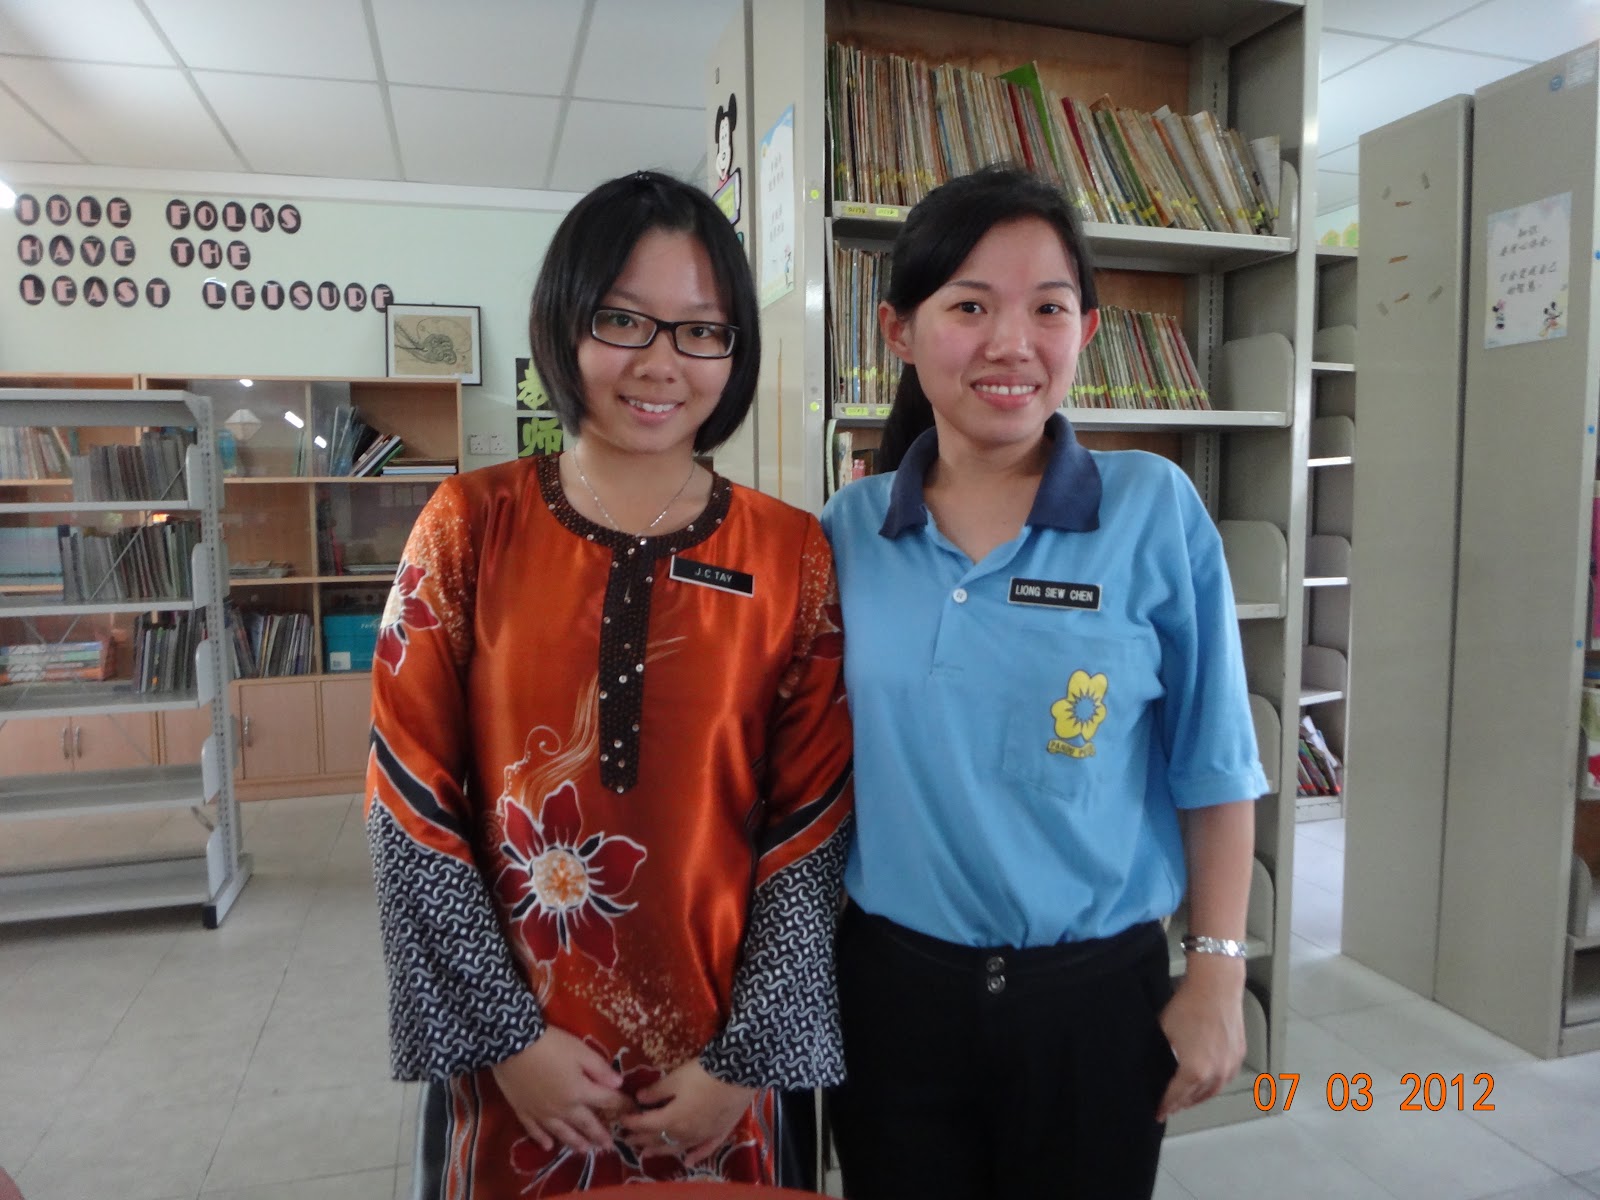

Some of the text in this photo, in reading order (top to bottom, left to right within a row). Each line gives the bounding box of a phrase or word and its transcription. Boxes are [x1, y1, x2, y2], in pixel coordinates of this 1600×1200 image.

[19, 198, 299, 229] IDLE FOLKS
[19, 238, 249, 267] HAVE THE
[22, 278, 168, 306] LEAST
[715, 571, 733, 583] TAY
[1015, 584, 1094, 602] LIONG SIEW CHEN
